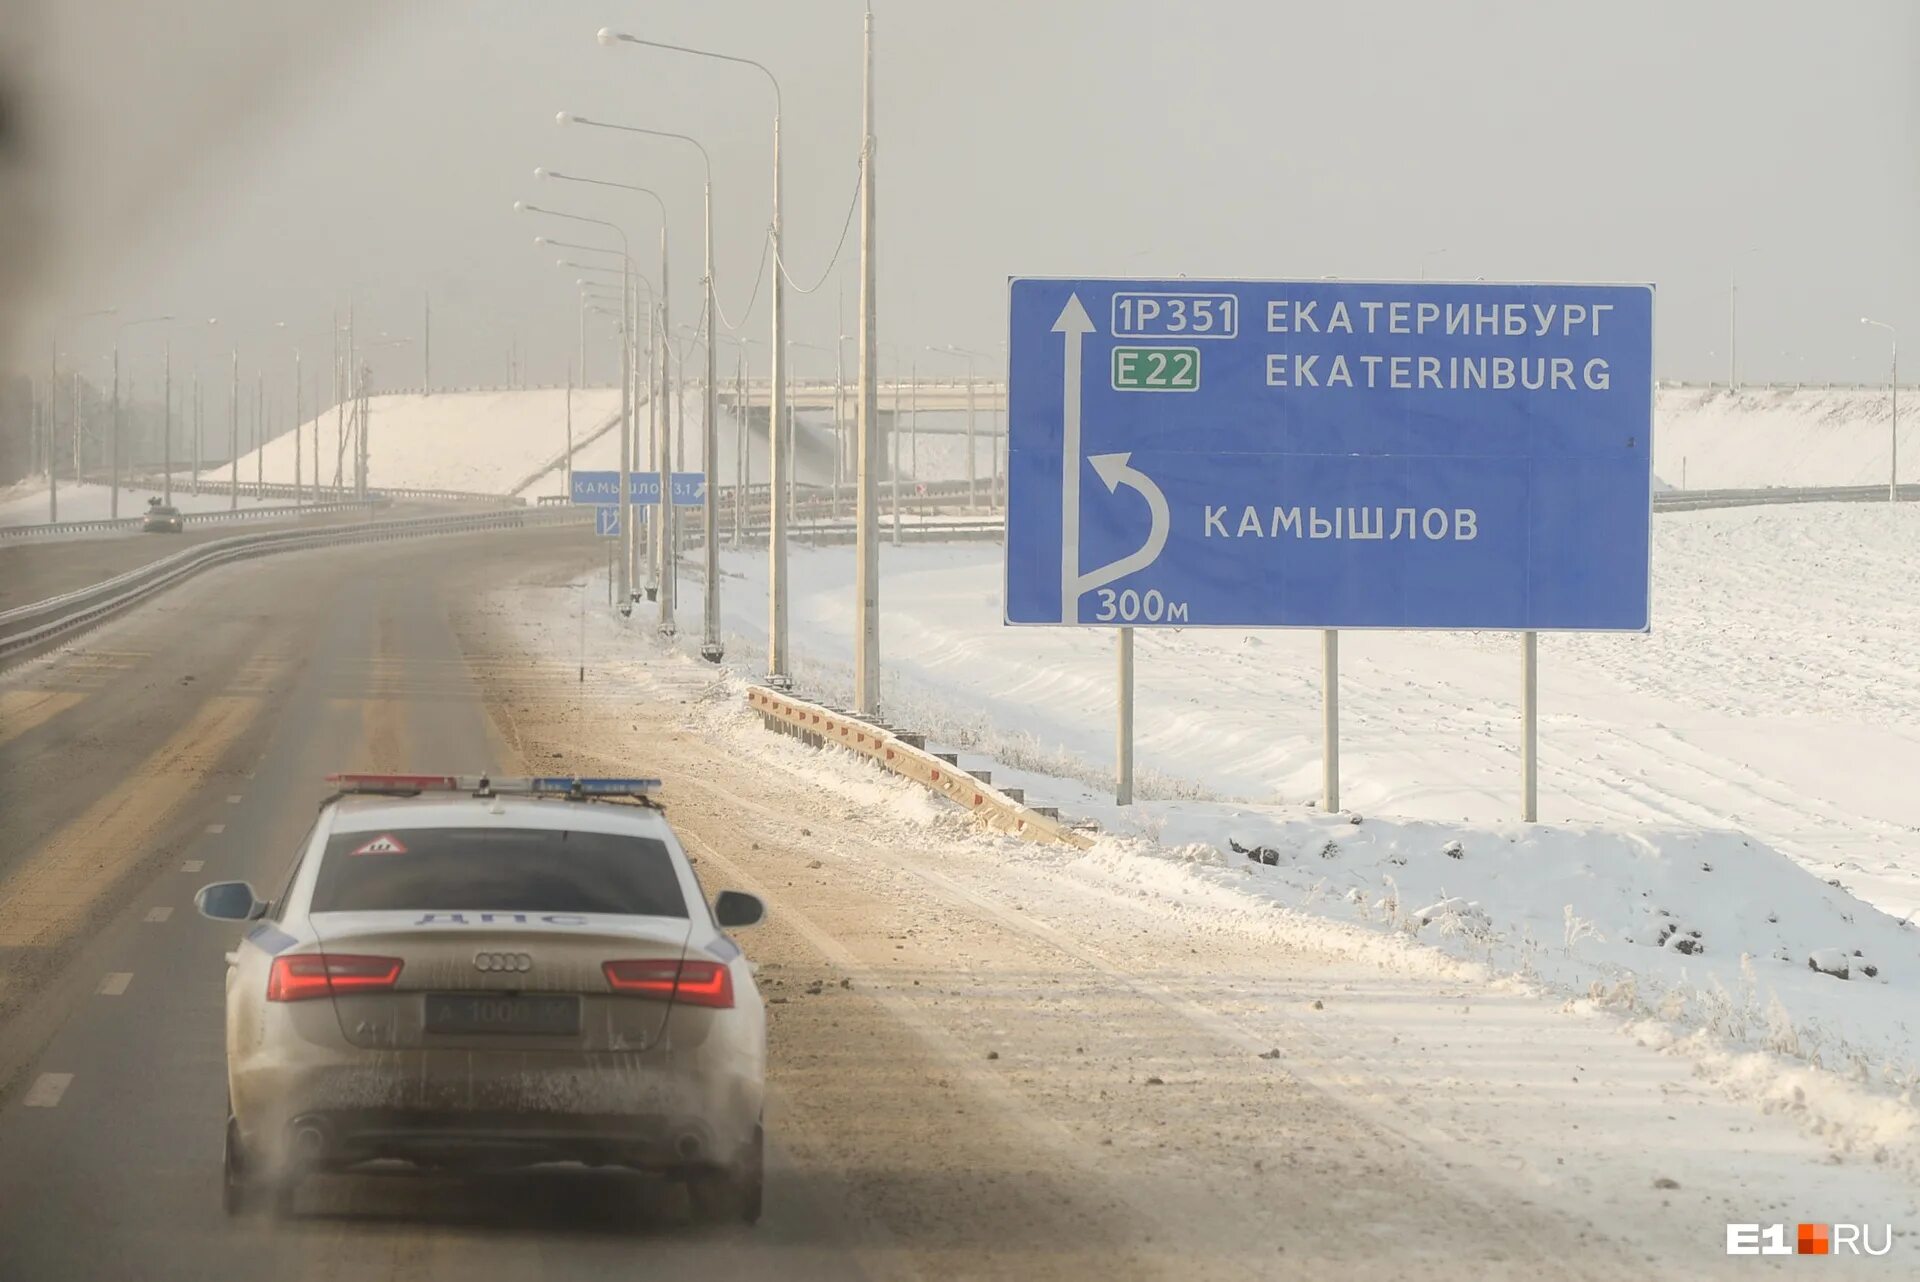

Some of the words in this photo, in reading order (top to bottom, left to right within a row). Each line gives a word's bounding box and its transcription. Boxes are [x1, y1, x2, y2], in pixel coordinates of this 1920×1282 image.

[1119, 299, 1232, 332] 1Р351
[1266, 300, 1614, 337] ЕКАТЕРИНБУРГ
[1118, 352, 1193, 385] E22
[1265, 354, 1610, 391] EKATERINBURG
[574, 481, 660, 495] КАМЫШЛО
[1204, 504, 1478, 541] КАМЫШЛОВ
[414, 913, 589, 926] ДПС
